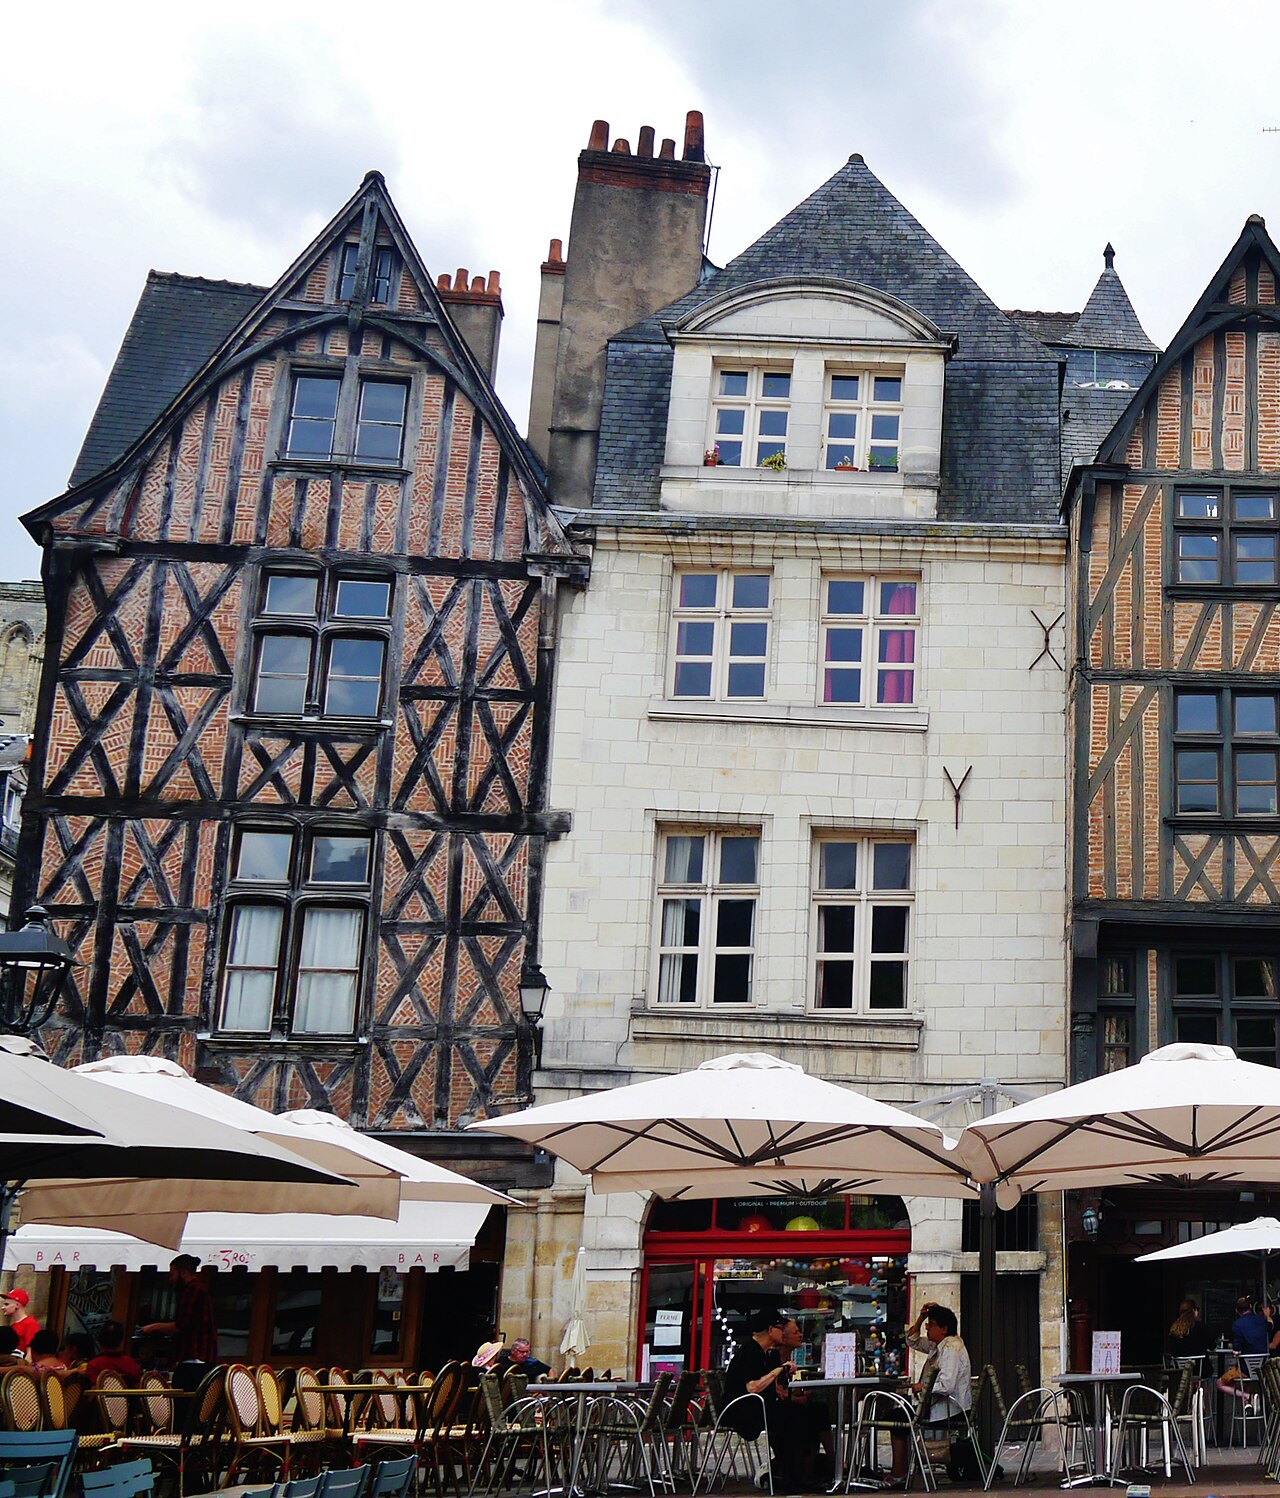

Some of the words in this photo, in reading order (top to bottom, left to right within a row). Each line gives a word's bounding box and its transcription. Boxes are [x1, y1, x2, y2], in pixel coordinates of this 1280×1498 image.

[36, 1251, 80, 1261] BAR
[219, 1249, 233, 1270] 3
[398, 1253, 440, 1263] BAR
